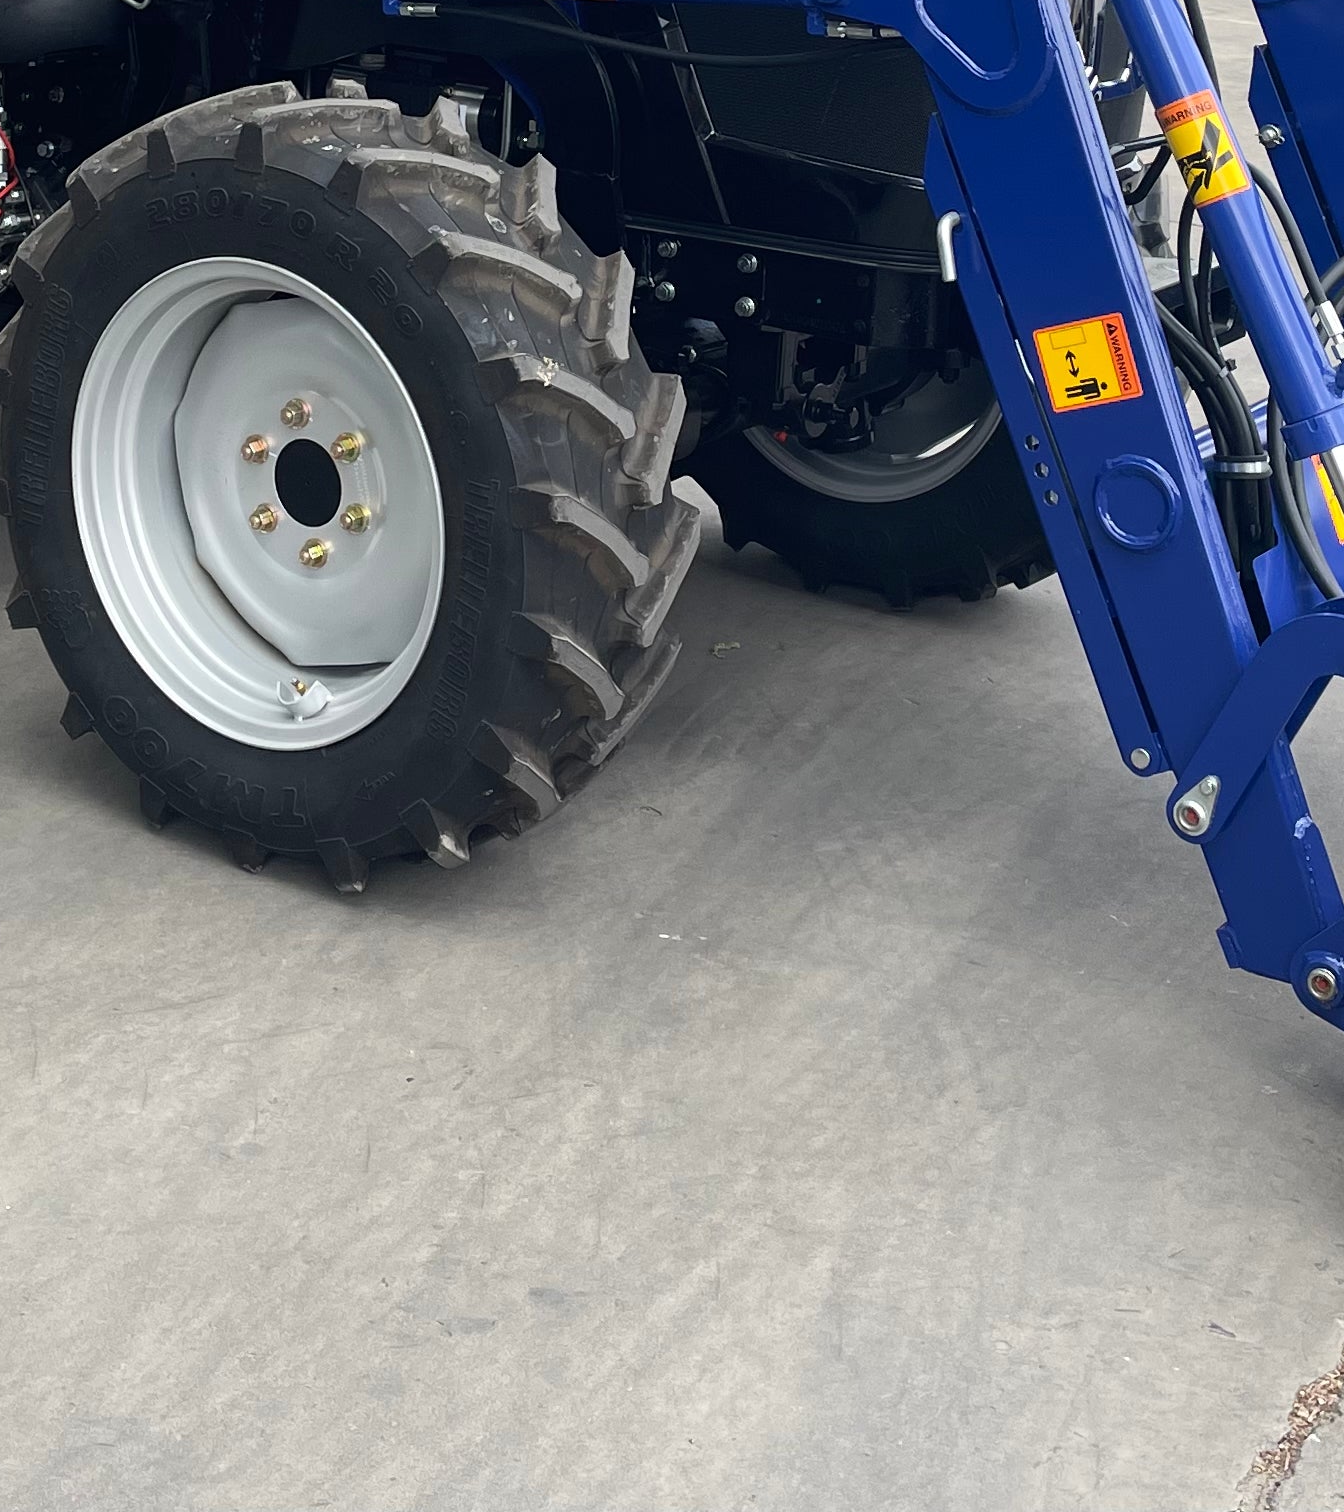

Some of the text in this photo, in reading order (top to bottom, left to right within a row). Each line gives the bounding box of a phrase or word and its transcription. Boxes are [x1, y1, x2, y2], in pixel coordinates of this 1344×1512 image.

[1162, 100, 1213, 129] WARNING
[144, 187, 424, 336] 280/70 R 20
[1110, 334, 1133, 392] WARNING
[104, 694, 306, 828] TM700
